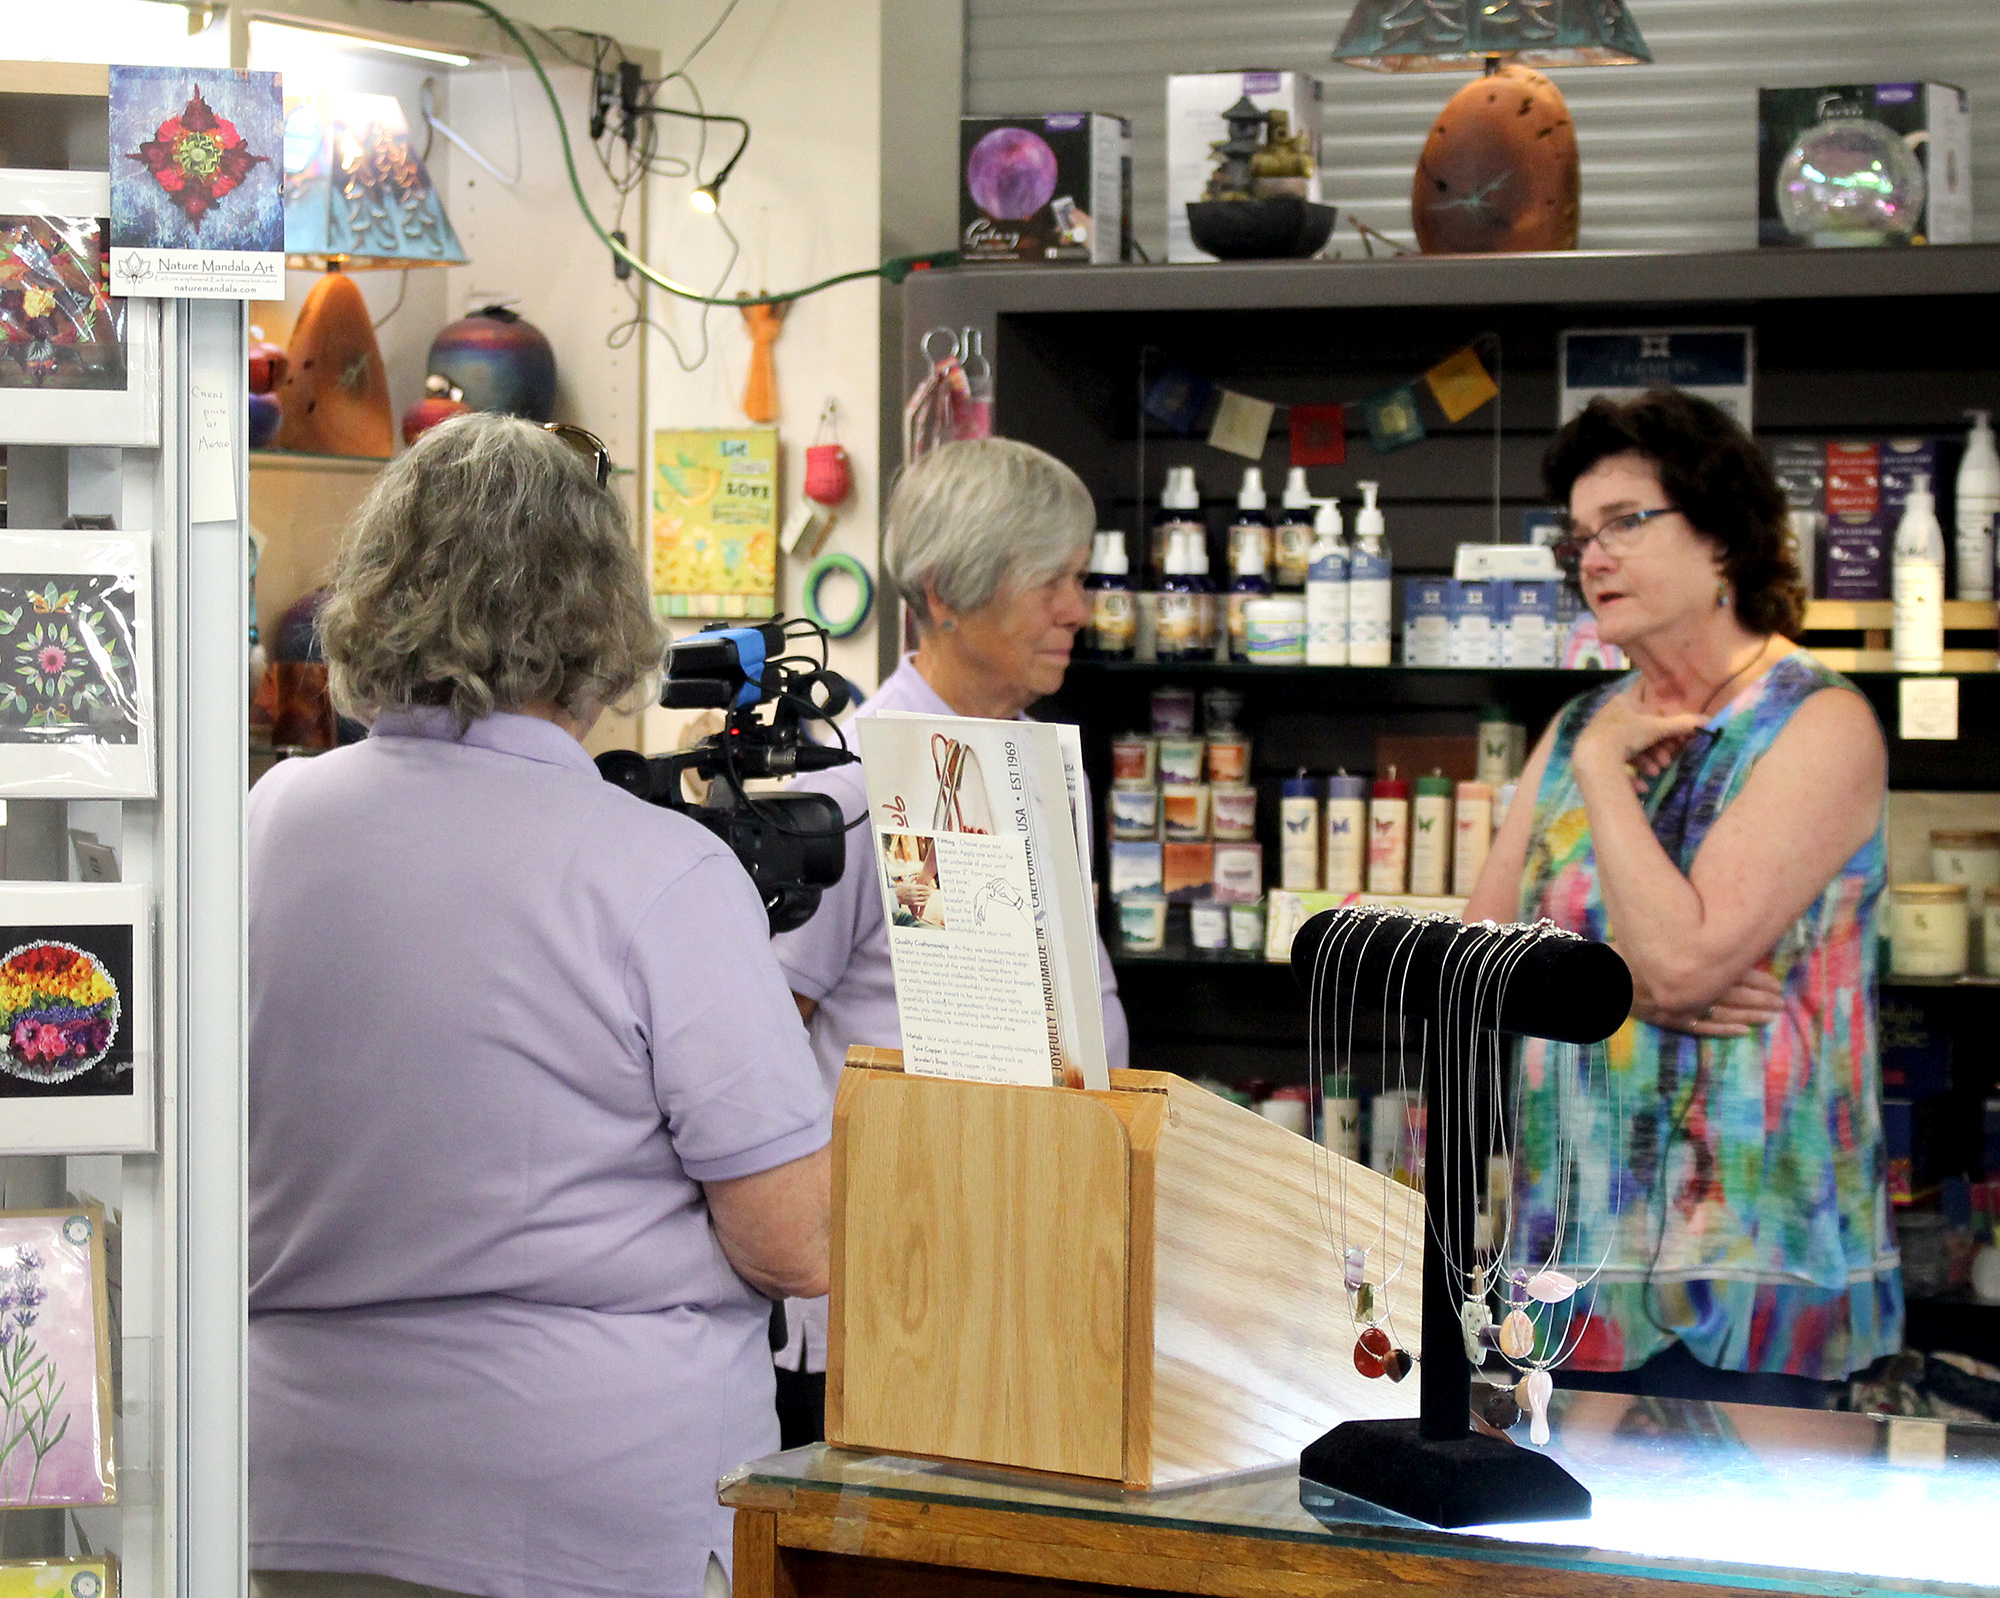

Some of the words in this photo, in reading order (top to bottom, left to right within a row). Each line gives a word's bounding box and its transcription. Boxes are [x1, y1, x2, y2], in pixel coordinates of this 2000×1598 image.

[158, 258, 199, 271] Nature
[202, 259, 250, 272] Mandala
[252, 261, 274, 274] Art
[174, 284, 257, 293] naturemandala.com
[1004, 741, 1018, 767] 1969
[1009, 771, 1022, 790] EST
[1015, 808, 1028, 831] USA
[895, 938, 913, 947] Quality
[1035, 927, 1045, 939] IN
[1038, 945, 1055, 1011] HANDMADE
[1046, 1016, 1063, 1071] JOYFULLY
